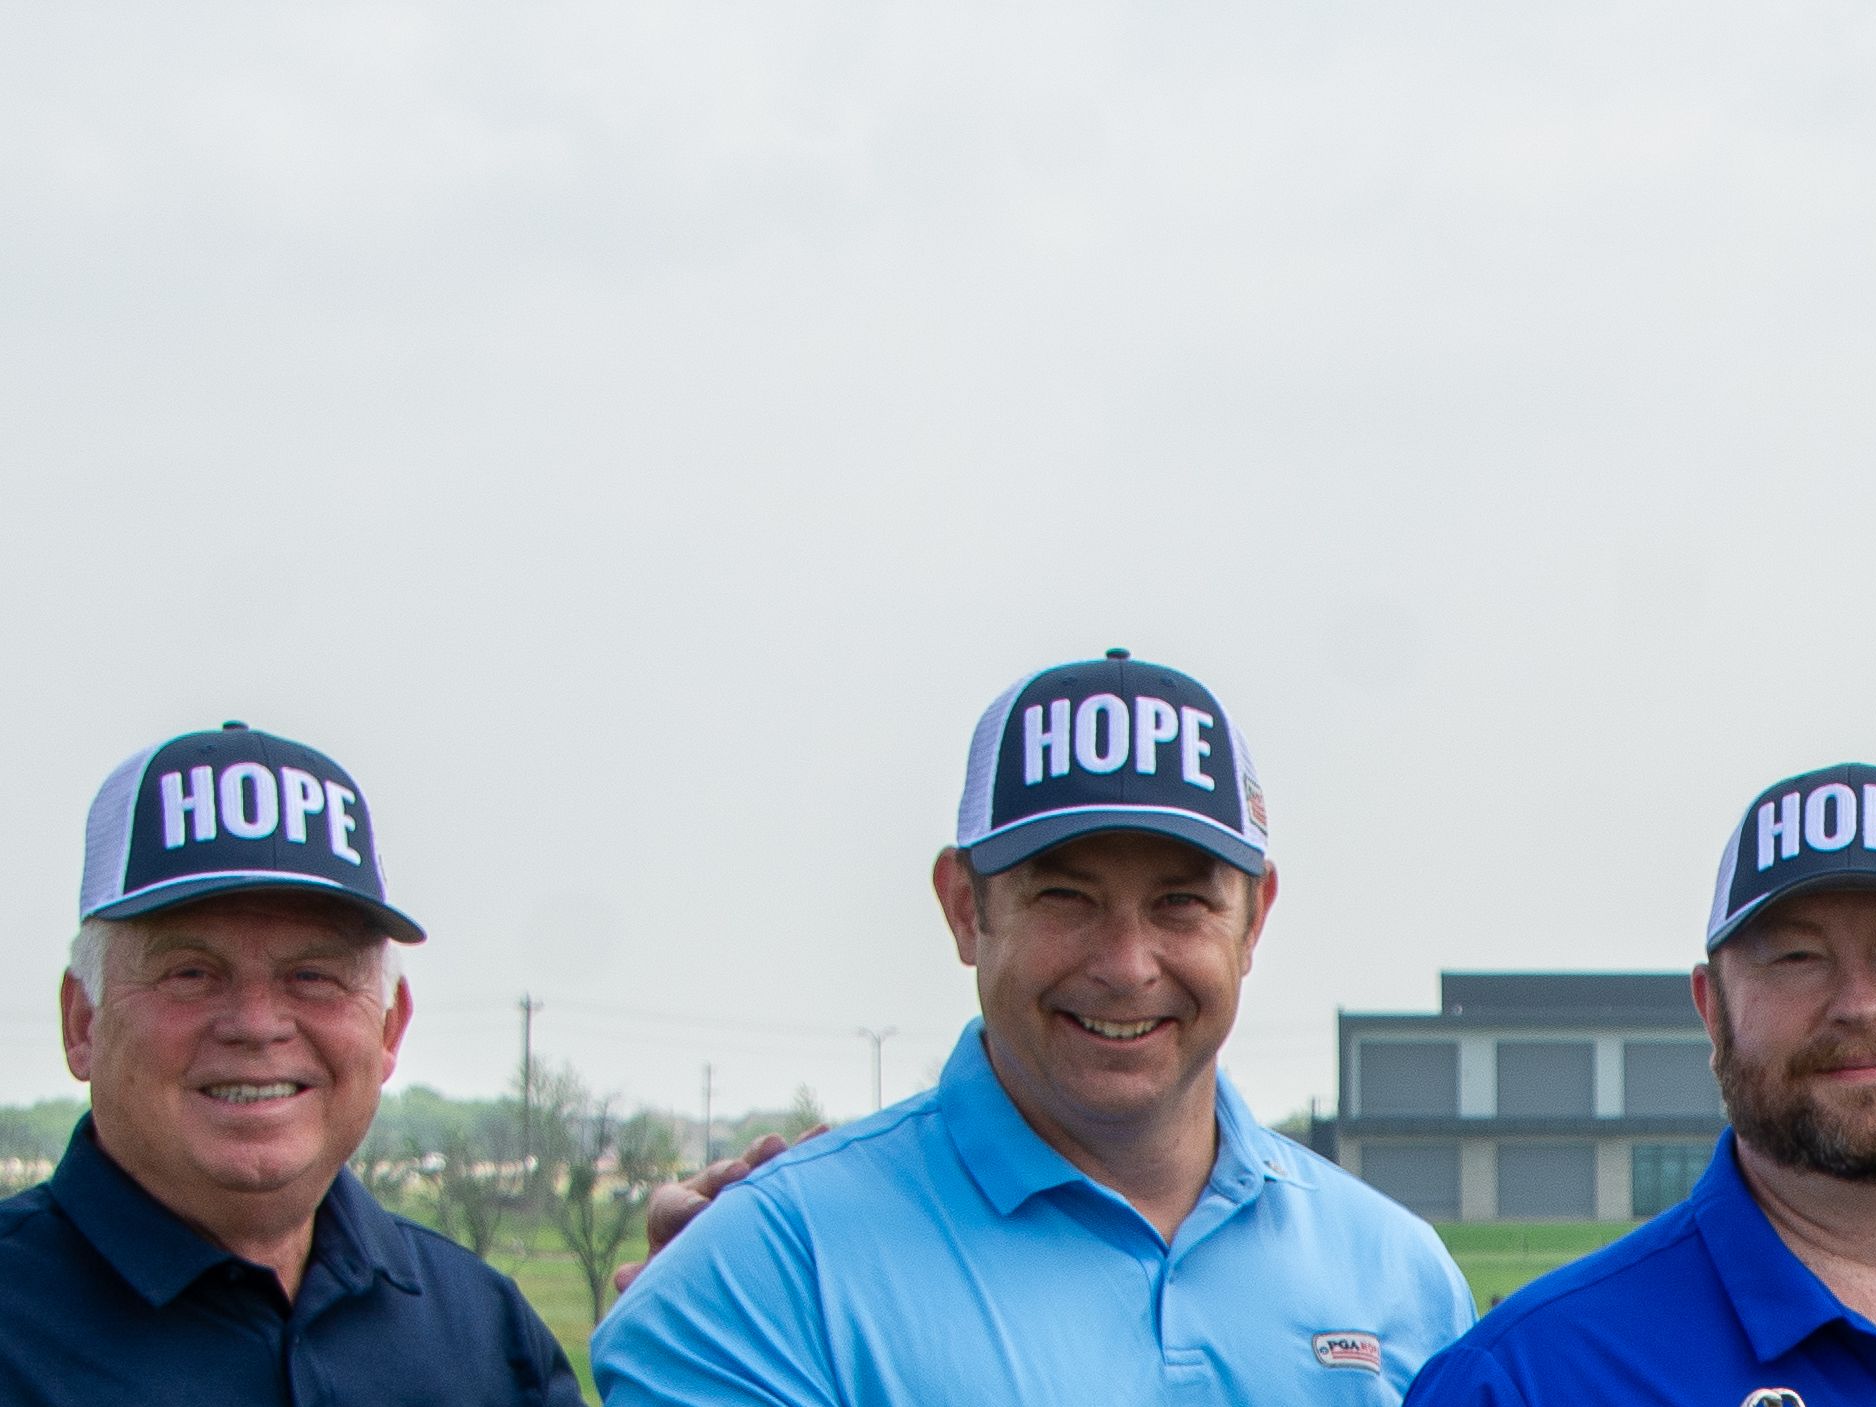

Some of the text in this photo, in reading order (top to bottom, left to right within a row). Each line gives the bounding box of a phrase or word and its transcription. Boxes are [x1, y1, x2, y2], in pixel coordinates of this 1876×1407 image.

[1023, 693, 1215, 792] HOPE
[160, 762, 362, 867] HOPE
[1327, 1339, 1360, 1351] PGA
